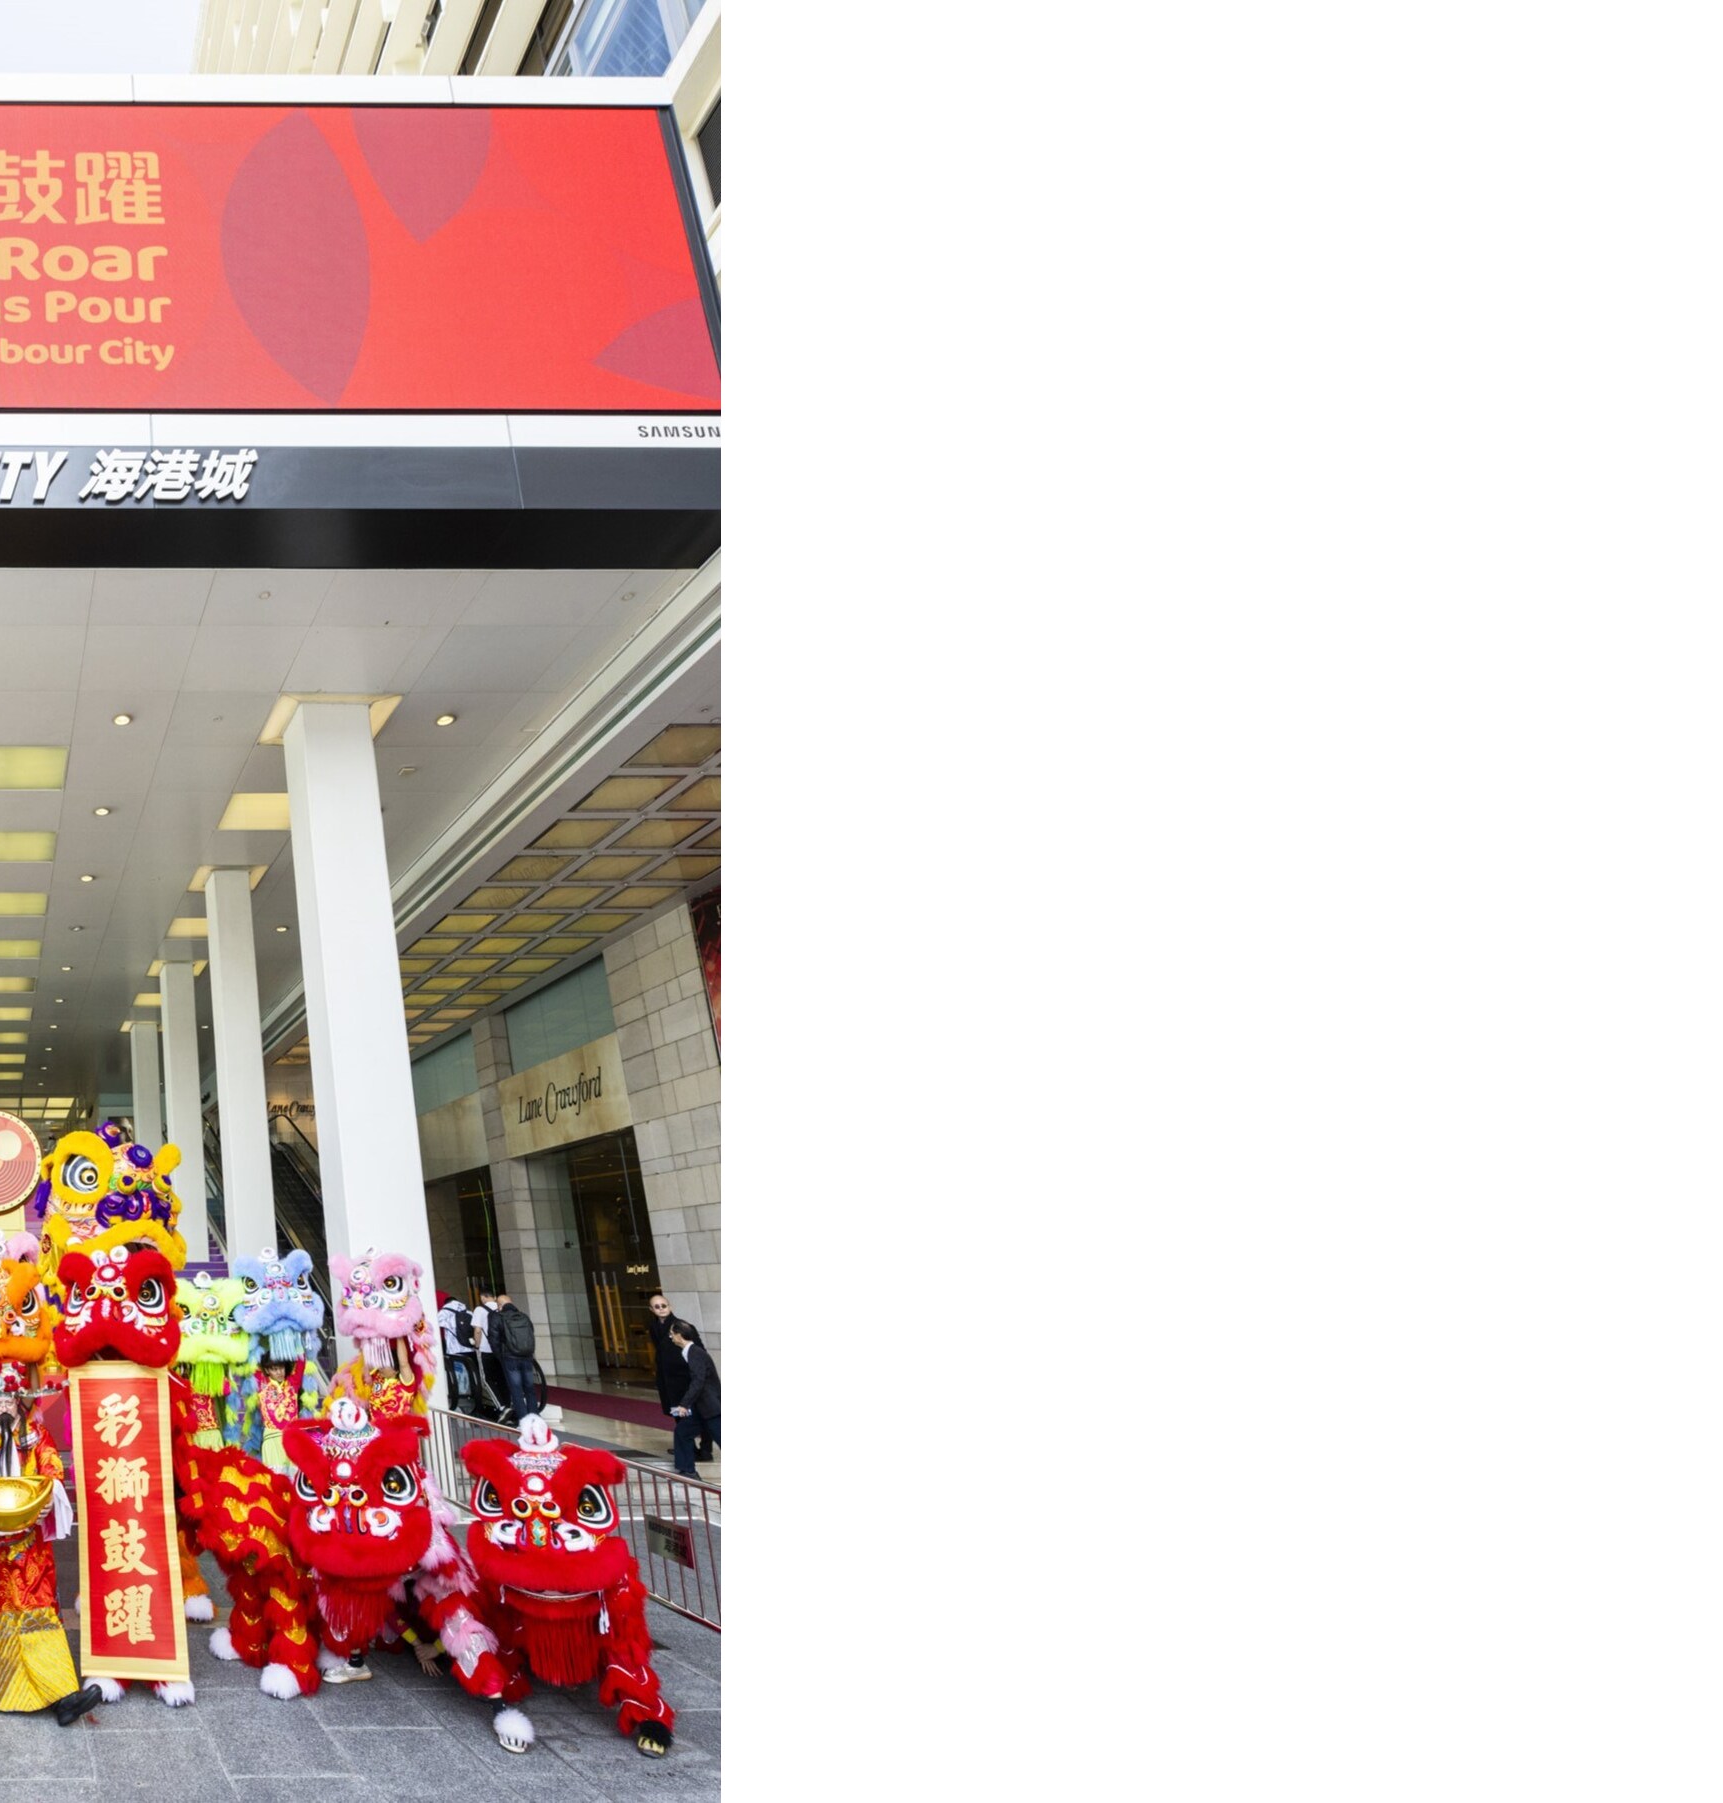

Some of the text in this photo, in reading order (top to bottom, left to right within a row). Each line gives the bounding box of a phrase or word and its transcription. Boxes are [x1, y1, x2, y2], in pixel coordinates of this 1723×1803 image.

[44, 290, 172, 324] Pour
[98, 337, 175, 372] City
[76, 447, 258, 503] 海港城
[518, 1065, 602, 1125] Lane Crawford
[92, 1392, 159, 1645] 彩獅鼓躍
